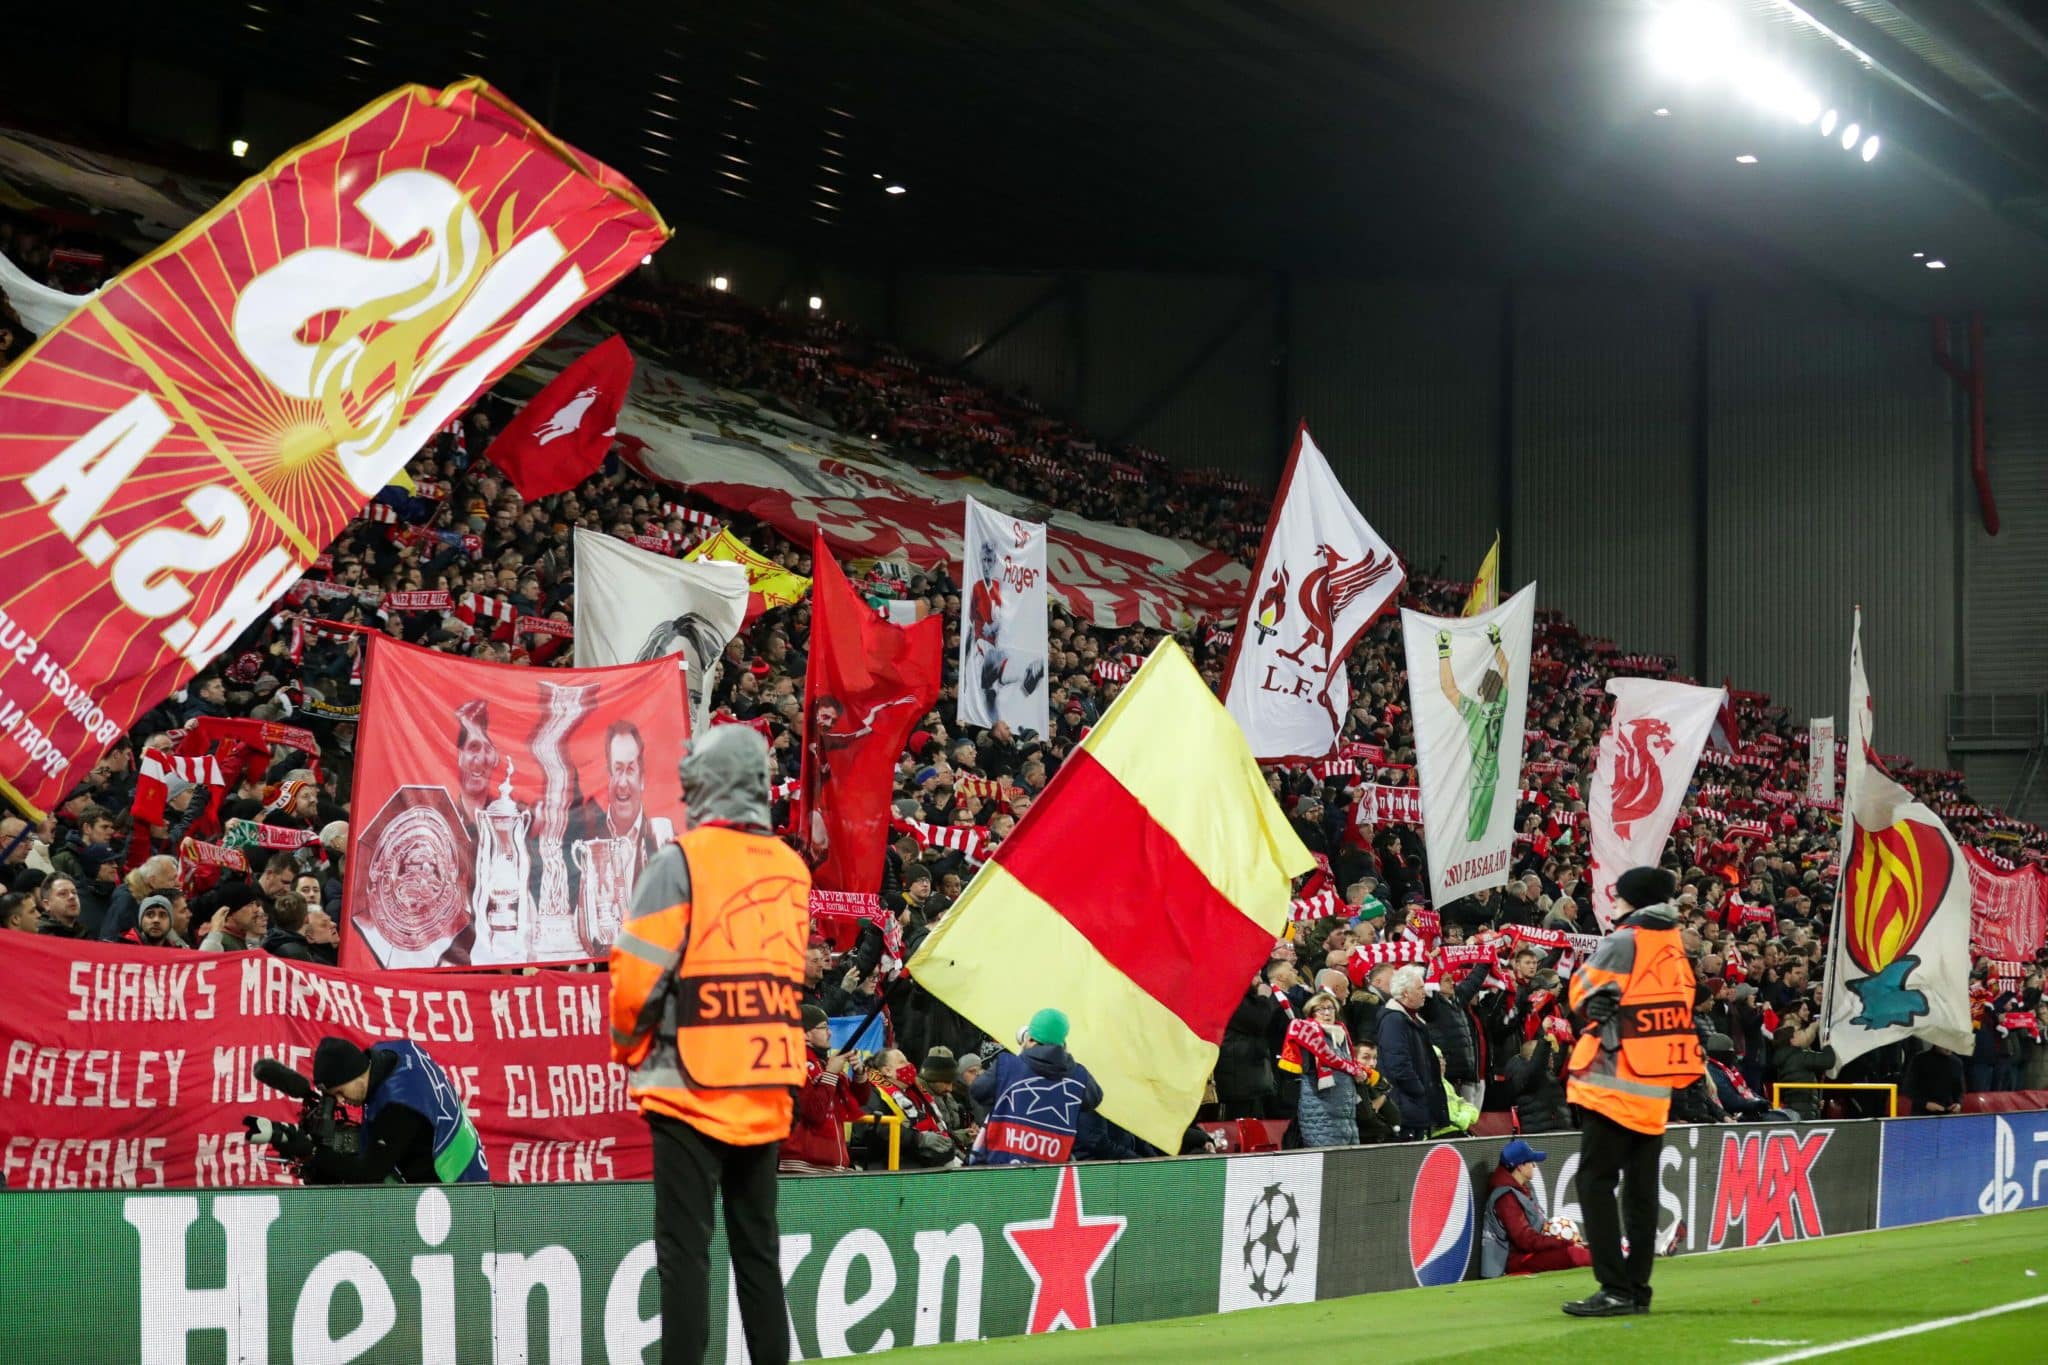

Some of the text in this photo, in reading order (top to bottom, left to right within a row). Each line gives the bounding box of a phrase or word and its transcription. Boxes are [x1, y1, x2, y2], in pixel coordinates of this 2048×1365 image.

[1003, 555, 1040, 594] Roger
[1516, 924, 1559, 943] THIAGO
[67, 957, 601, 1042] SHANKS MARMALIZED MILAN
[1636, 1006, 1695, 1032] STEW
[3, 1040, 186, 1109] PAISLEY
[750, 1036, 799, 1070] 21
[3, 1136, 167, 1189] FAGANS
[195, 1132, 290, 1188] MAK
[508, 1137, 616, 1184] RUINS
[1708, 1128, 1835, 1250] MAX
